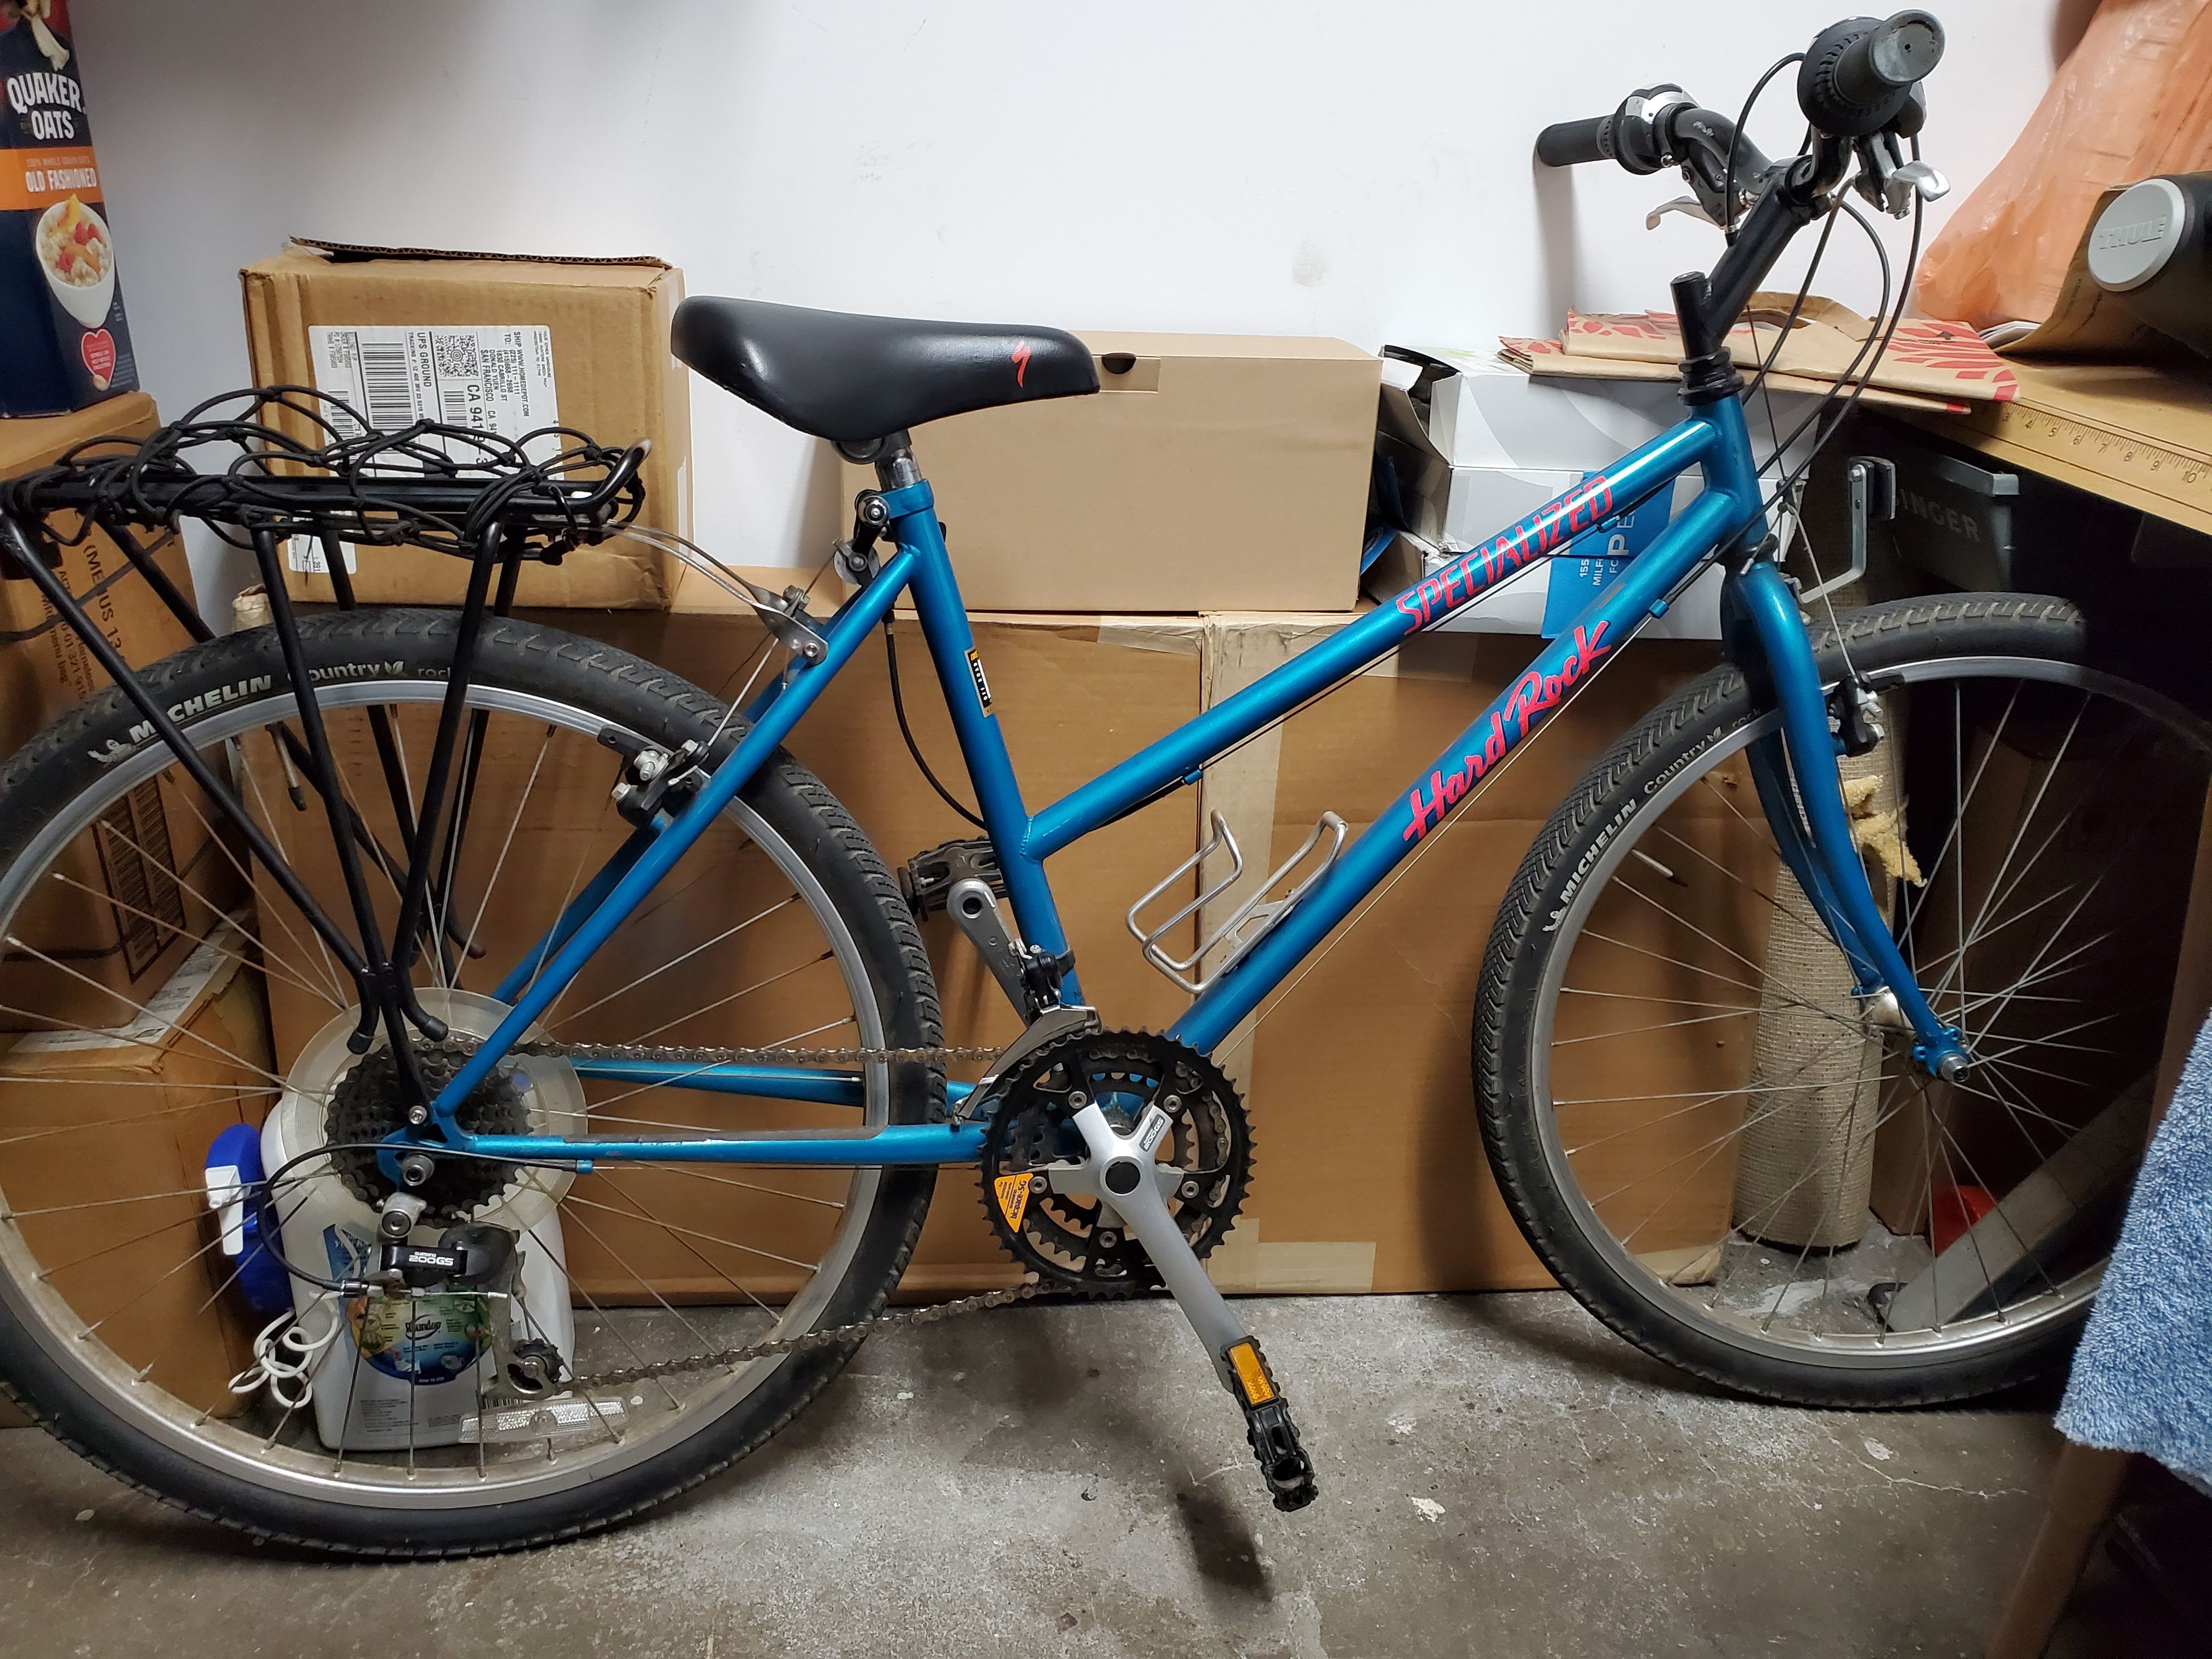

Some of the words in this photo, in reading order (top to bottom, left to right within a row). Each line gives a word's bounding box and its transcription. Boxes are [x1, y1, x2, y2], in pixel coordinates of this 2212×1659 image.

[7, 72, 82, 114] QUAKER
[31, 110, 75, 140] OATS
[25, 171, 46, 193] OLD
[47, 167, 97, 190] FASHIONED
[2100, 218, 2166, 250] THULE
[408, 332, 417, 357] TRACKING
[417, 332, 427, 349] UPS
[514, 331, 522, 347] SHIP
[420, 352, 432, 387] GROUND
[489, 349, 498, 373] DONALD
[467, 385, 481, 402] CA
[483, 365, 494, 402] FRANCISCO
[498, 365, 506, 393] CABRILLO
[517, 349, 530, 417] WWW.HOMEDEPOT.COM
[488, 410, 496, 419] CA
[2025, 420, 2032, 429] 4
[2049, 427, 2057, 438] 5
[2073, 435, 2081, 445] 6
[2098, 443, 2107, 454] 7
[2124, 452, 2133, 462] 8
[2150, 460, 2160, 471] 9
[2182, 470, 2197, 483] 10
[1896, 488, 1982, 542] INGER
[1396, 476, 1613, 635] SPECIALIZED
[83, 544, 115, 623] (MEUS
[1593, 558, 1605, 586] MILF
[129, 674, 272, 743] MCHELIN
[1403, 711, 1508, 842] Hard
[1503, 620, 1612, 739] Rock
[1559, 797, 1638, 905] MICHELIN
[1644, 740, 1706, 795] Country
[1143, 1118, 1164, 1150] 200GS
[1009, 1180, 1027, 1220] biopace-SG
[408, 1254, 455, 1267] 200GS
[405, 1318, 442, 1334] Rundup
